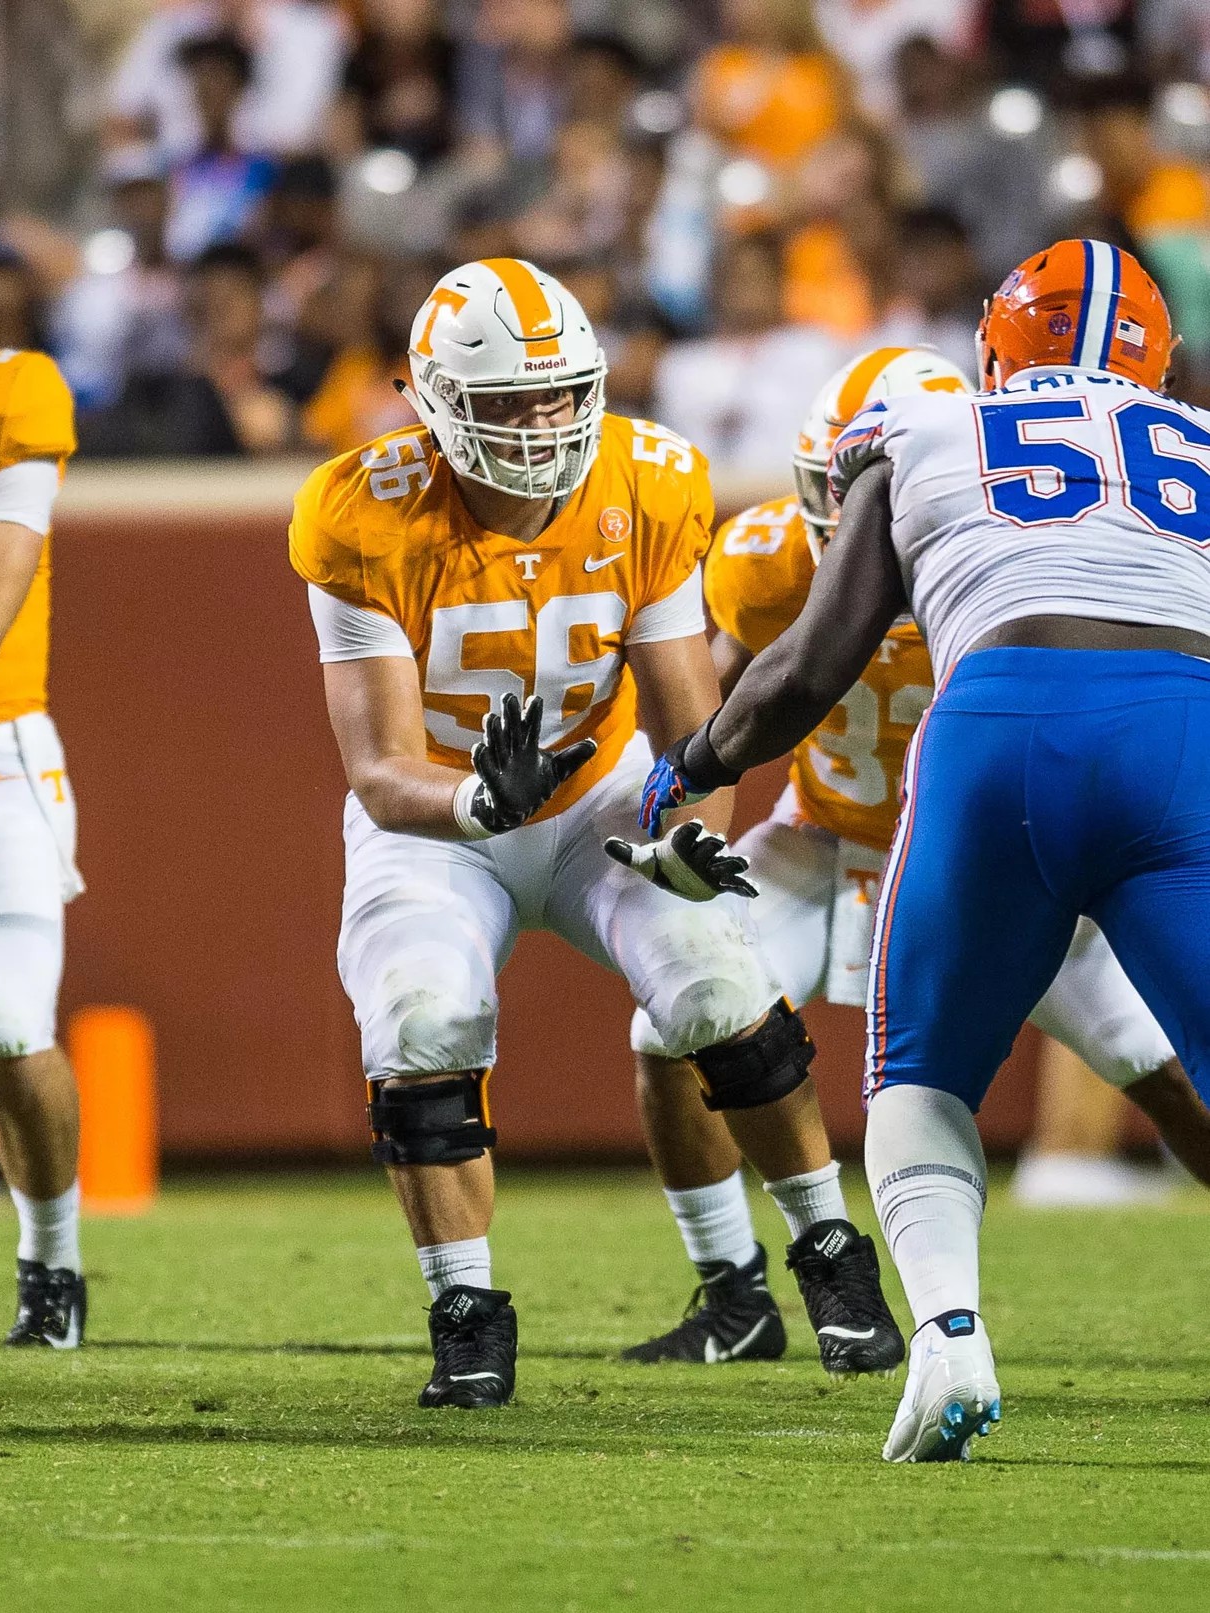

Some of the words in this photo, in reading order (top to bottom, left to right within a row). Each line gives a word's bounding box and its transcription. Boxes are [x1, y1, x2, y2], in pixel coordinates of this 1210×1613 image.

[415, 287, 468, 358] T
[524, 357, 568, 372] Riddell
[360, 435, 432, 501] 56
[971, 396, 1210, 549] 56
[515, 553, 541, 580] T
[424, 591, 628, 752] 56
[40, 768, 65, 804] T
[822, 1228, 844, 1258] FORCE
